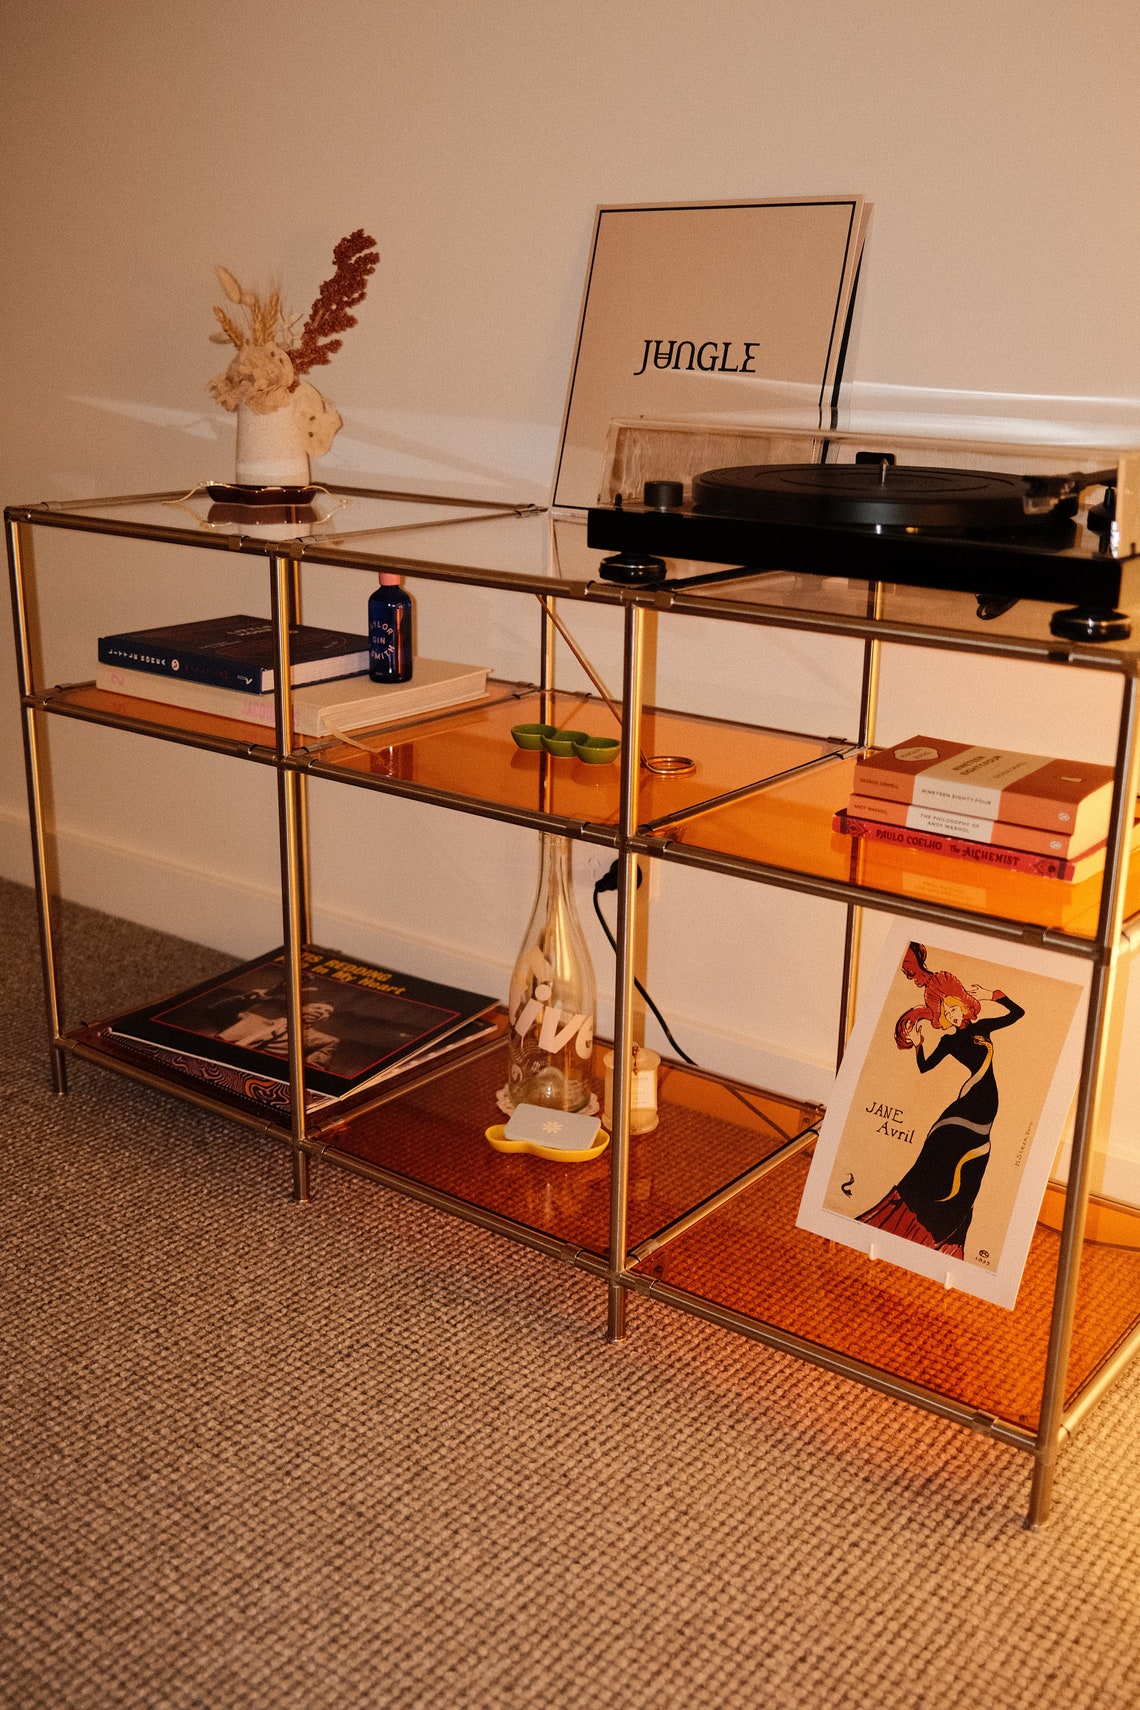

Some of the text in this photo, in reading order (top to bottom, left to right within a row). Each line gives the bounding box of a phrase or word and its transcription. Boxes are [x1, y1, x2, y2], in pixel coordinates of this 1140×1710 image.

[633, 339, 760, 376] JUNGLE
[372, 636, 386, 645] GIN
[371, 644, 396, 661] SMITH
[921, 788, 951, 798] NINETEEN
[927, 821, 970, 834] ANDY WARHOL
[932, 815, 970, 827] PHILOSOPHY
[875, 829, 904, 843] PAULO
[906, 835, 942, 851] COELHO
[324, 959, 393, 982] REDDING
[357, 977, 406, 995] Heart
[865, 1101, 904, 1124] JANE
[876, 1120, 916, 1144] Avril
